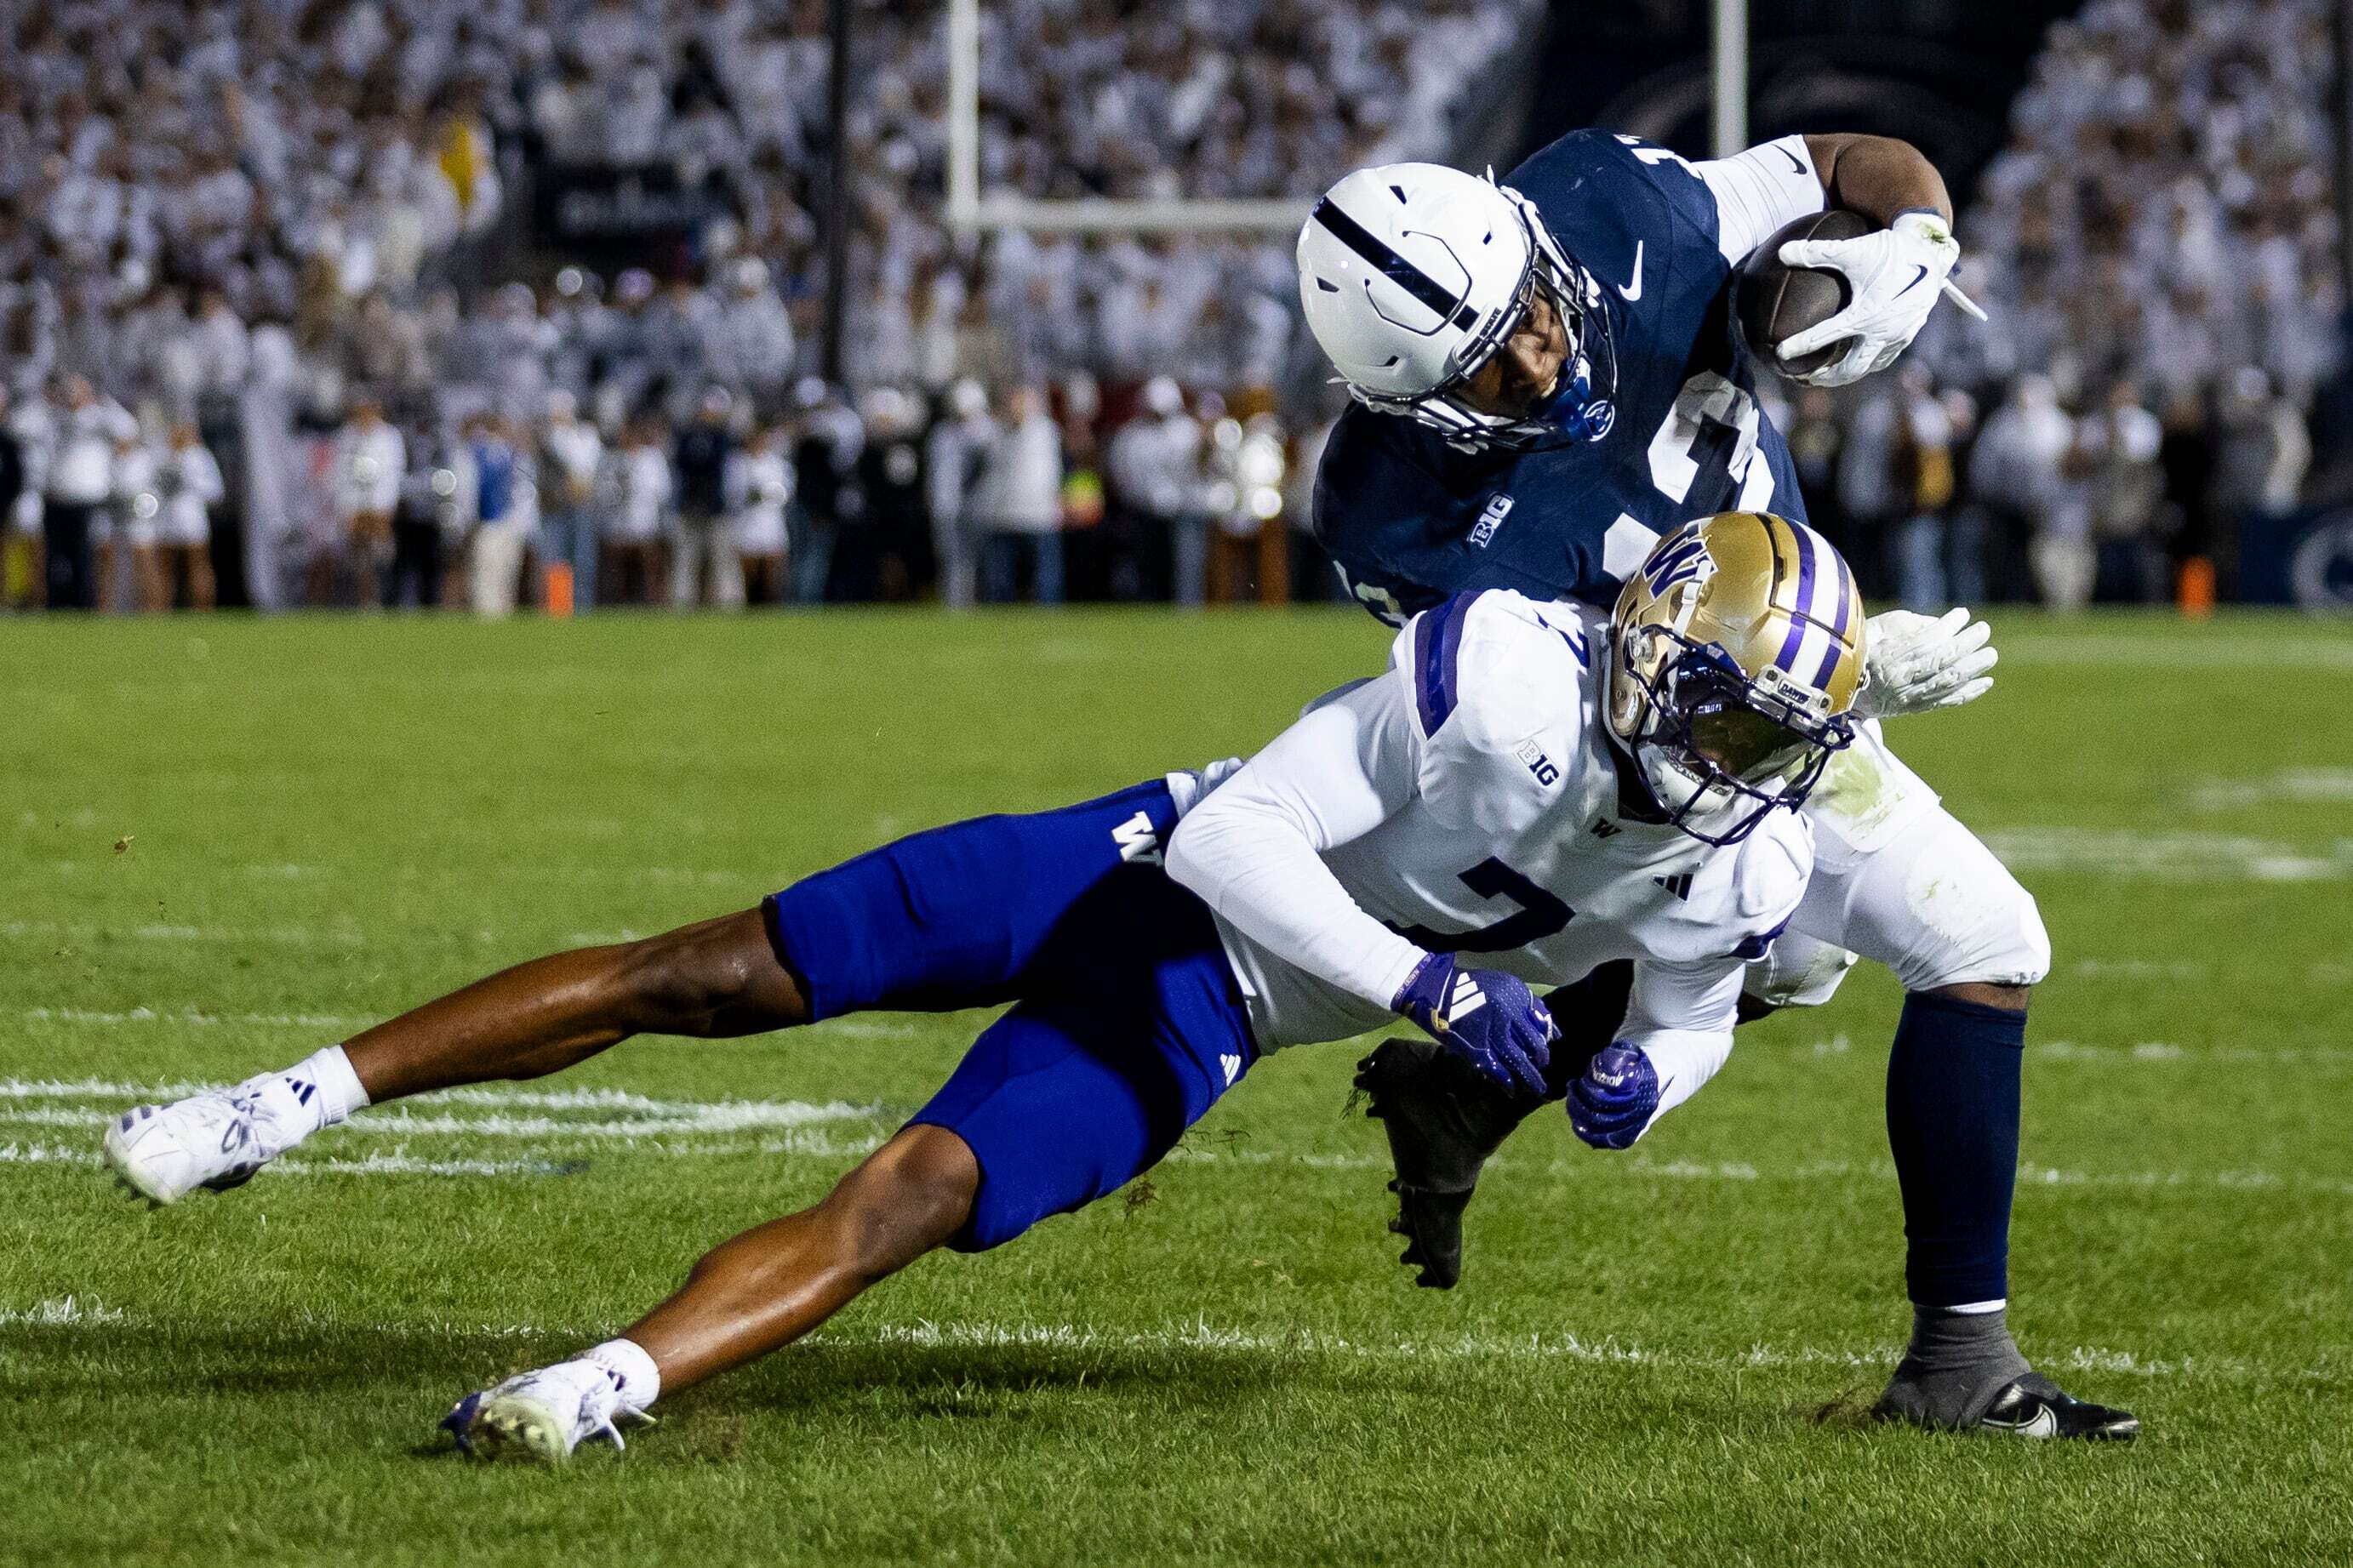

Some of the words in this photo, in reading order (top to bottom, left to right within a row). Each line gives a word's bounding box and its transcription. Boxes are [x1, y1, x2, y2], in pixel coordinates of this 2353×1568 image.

[1469, 493, 1513, 549] BIG
[1642, 520, 1719, 602] W
[1516, 738, 1560, 787] BIG
[1109, 809, 1165, 868] W
[1591, 817, 1622, 839] W
[1381, 855, 1577, 954] 7
